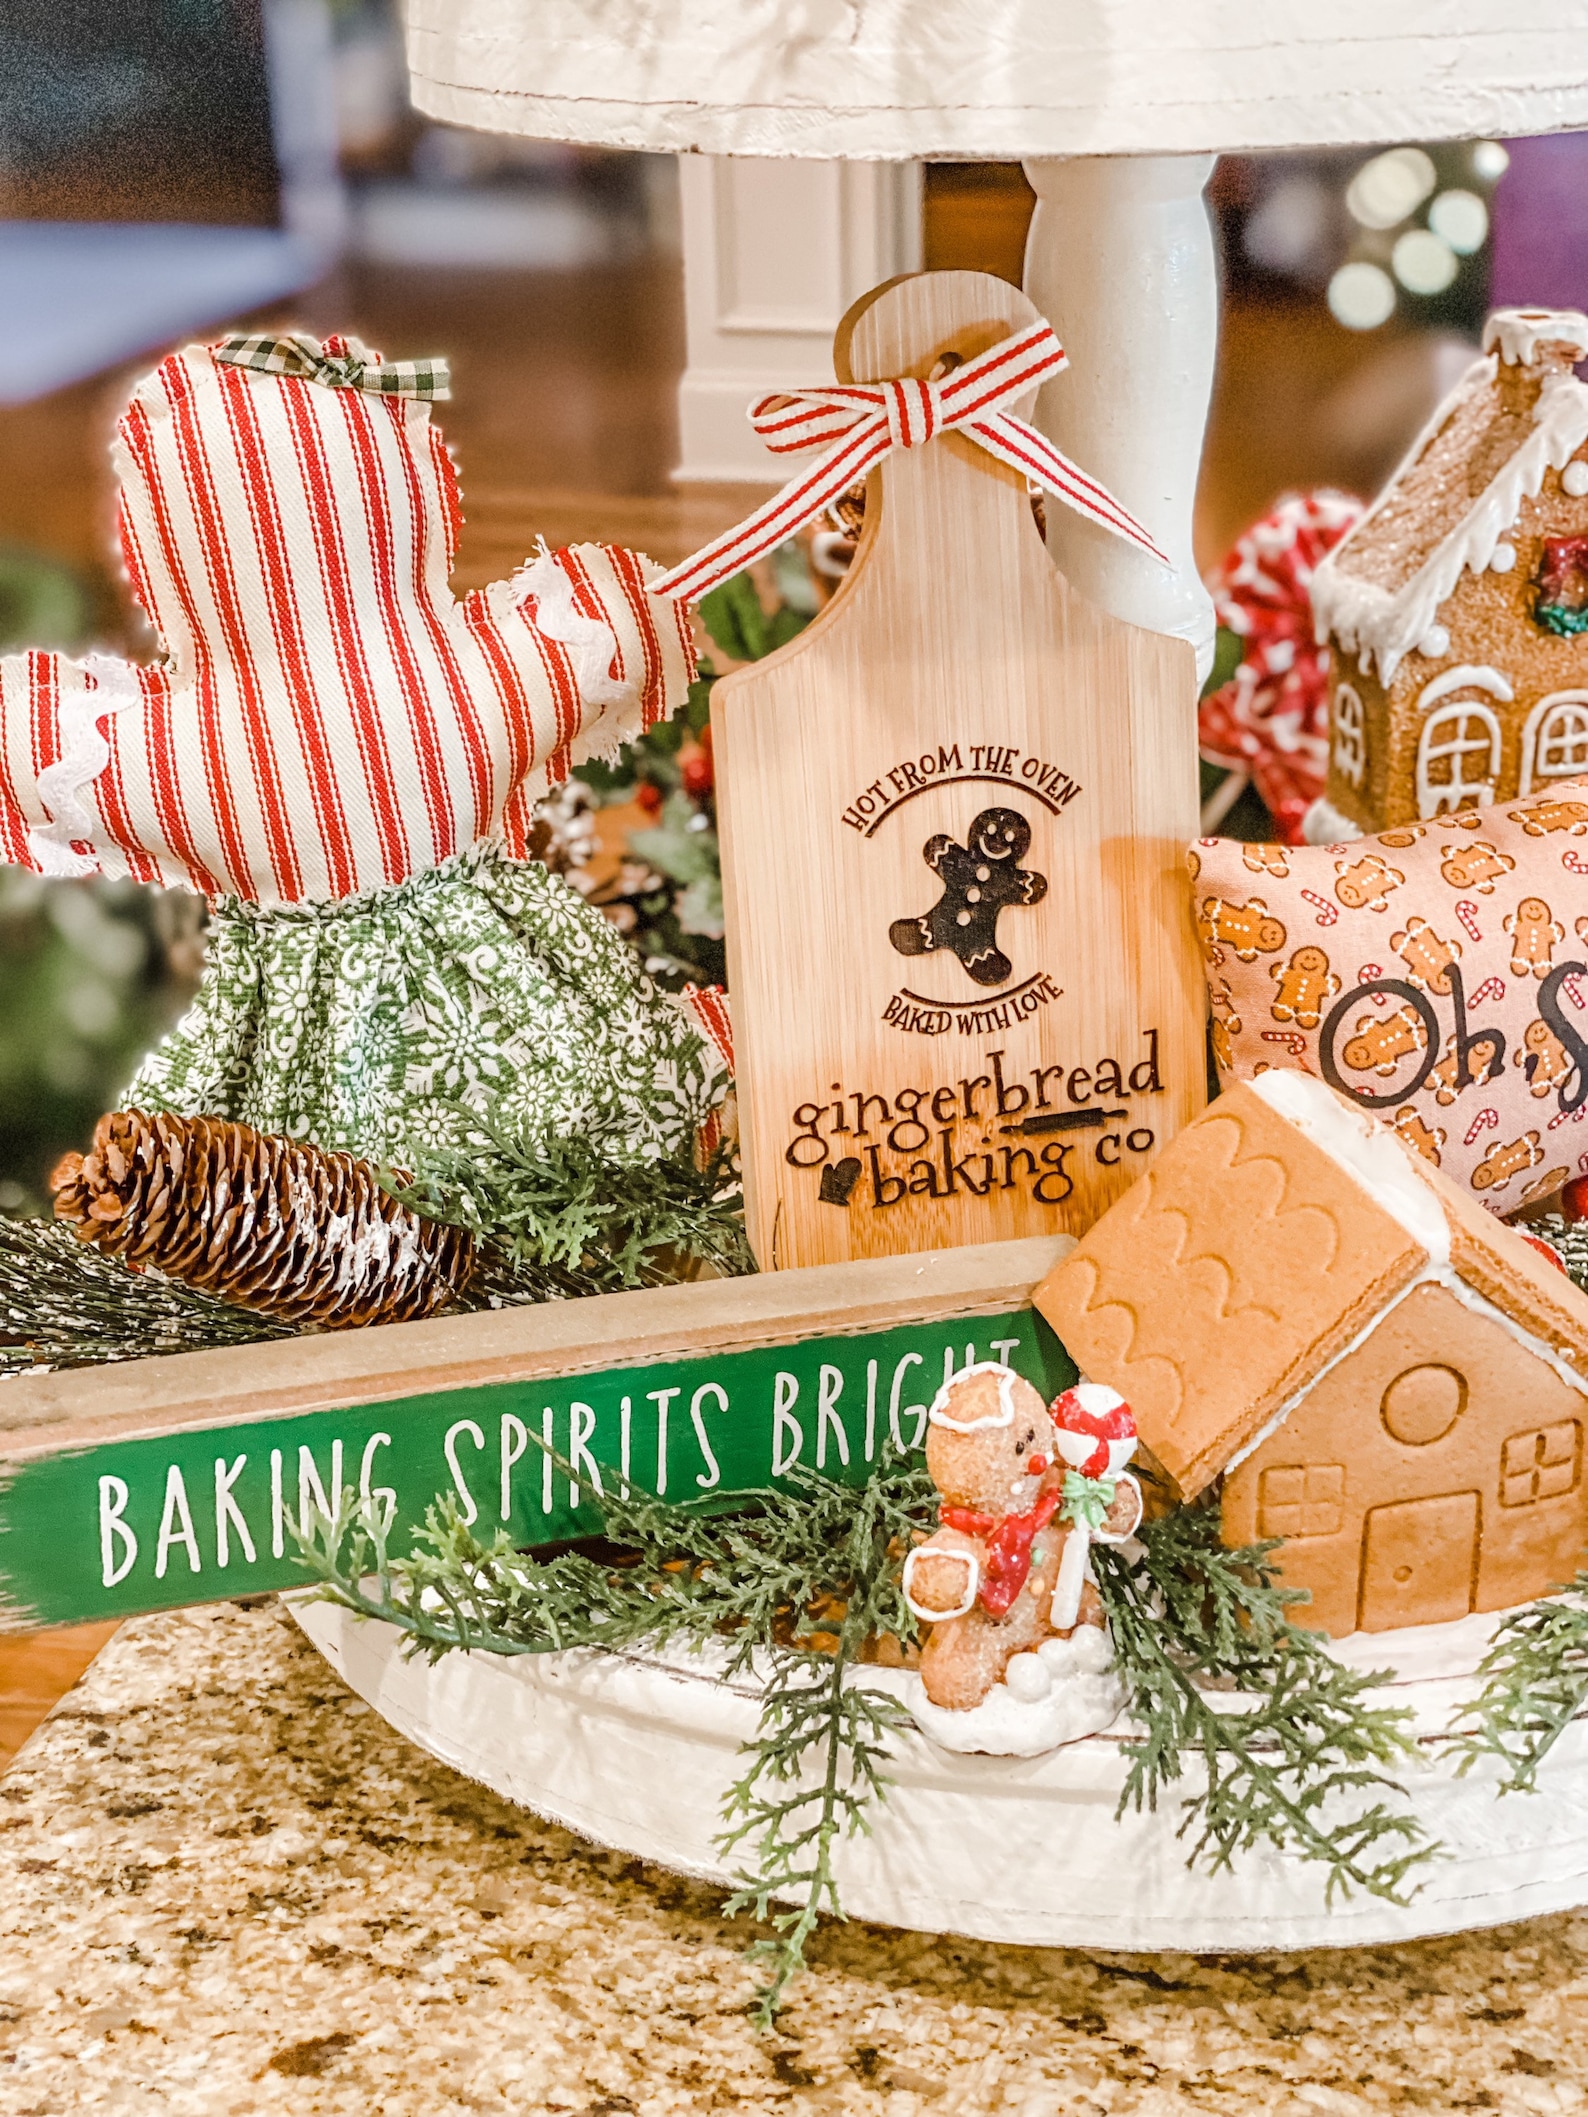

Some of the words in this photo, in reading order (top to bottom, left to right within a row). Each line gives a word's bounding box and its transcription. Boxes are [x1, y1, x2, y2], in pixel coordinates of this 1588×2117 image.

[841, 780, 891, 832] HOT
[886, 744, 964, 793] FROM
[970, 744, 1019, 776] THE
[1021, 757, 1083, 806] OVEN
[881, 995, 952, 1036] BAKED
[956, 1003, 1012, 1036] WITH
[1009, 974, 1064, 1023] LOVE
[785, 1028, 1165, 1168] gingerbread
[863, 1127, 1074, 1209] baking
[1095, 1127, 1154, 1166] co
[98, 1432, 397, 1588] BAKING
[444, 1382, 729, 1526] SPIRITS
